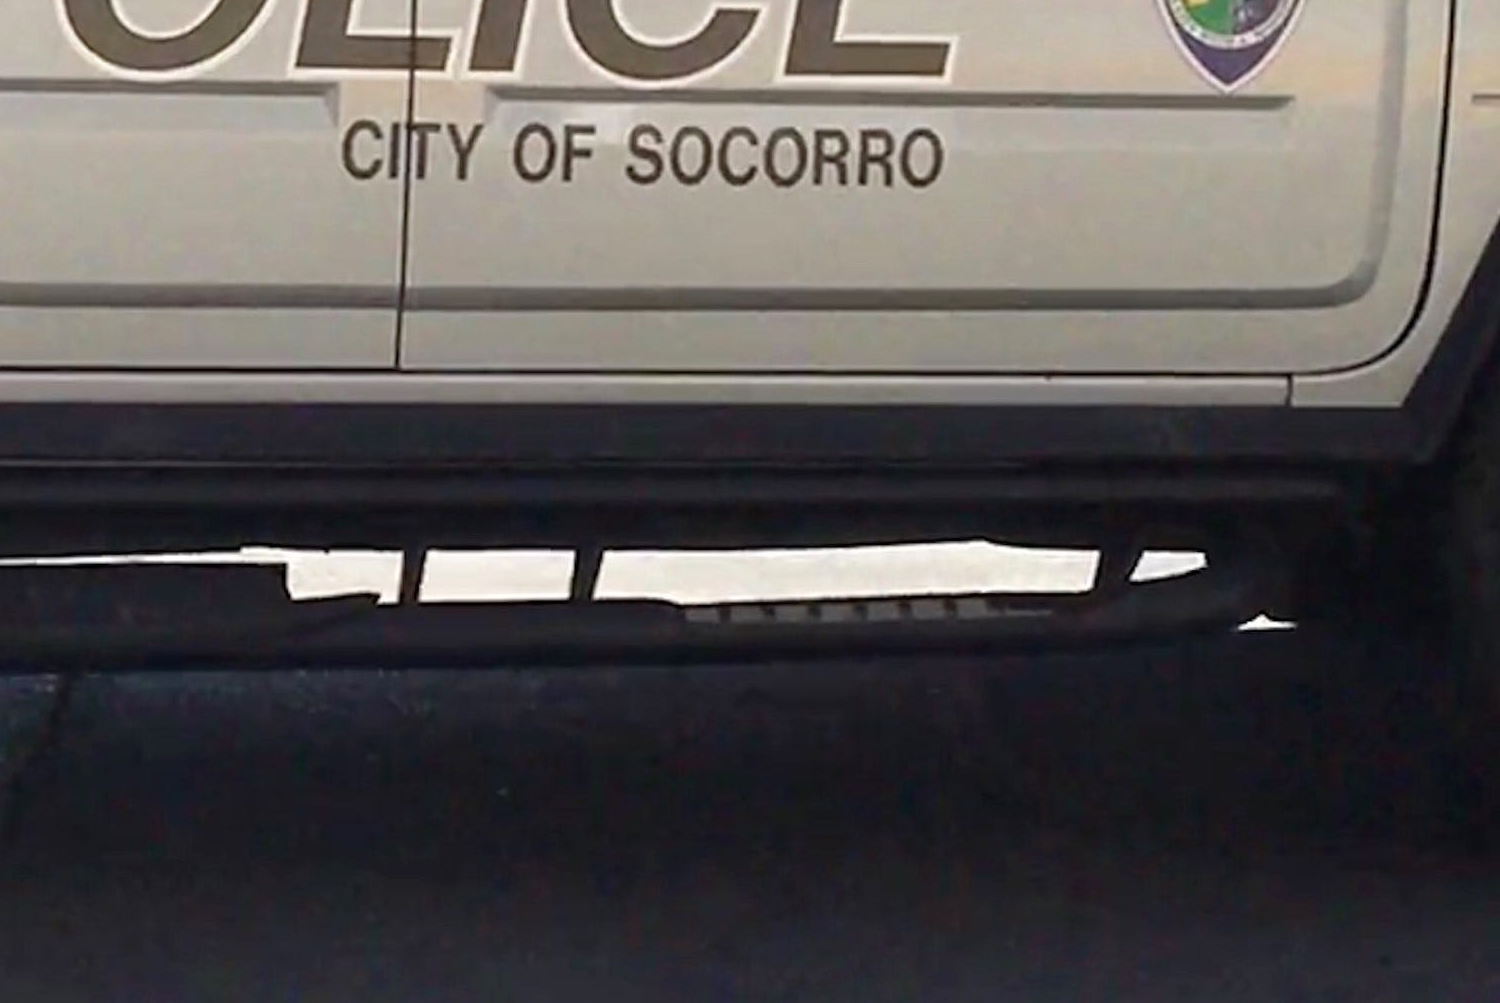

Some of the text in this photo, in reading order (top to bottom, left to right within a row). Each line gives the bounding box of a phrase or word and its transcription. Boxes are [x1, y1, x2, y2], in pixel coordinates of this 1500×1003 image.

[341, 120, 944, 189] CITY OF SOCORRO
